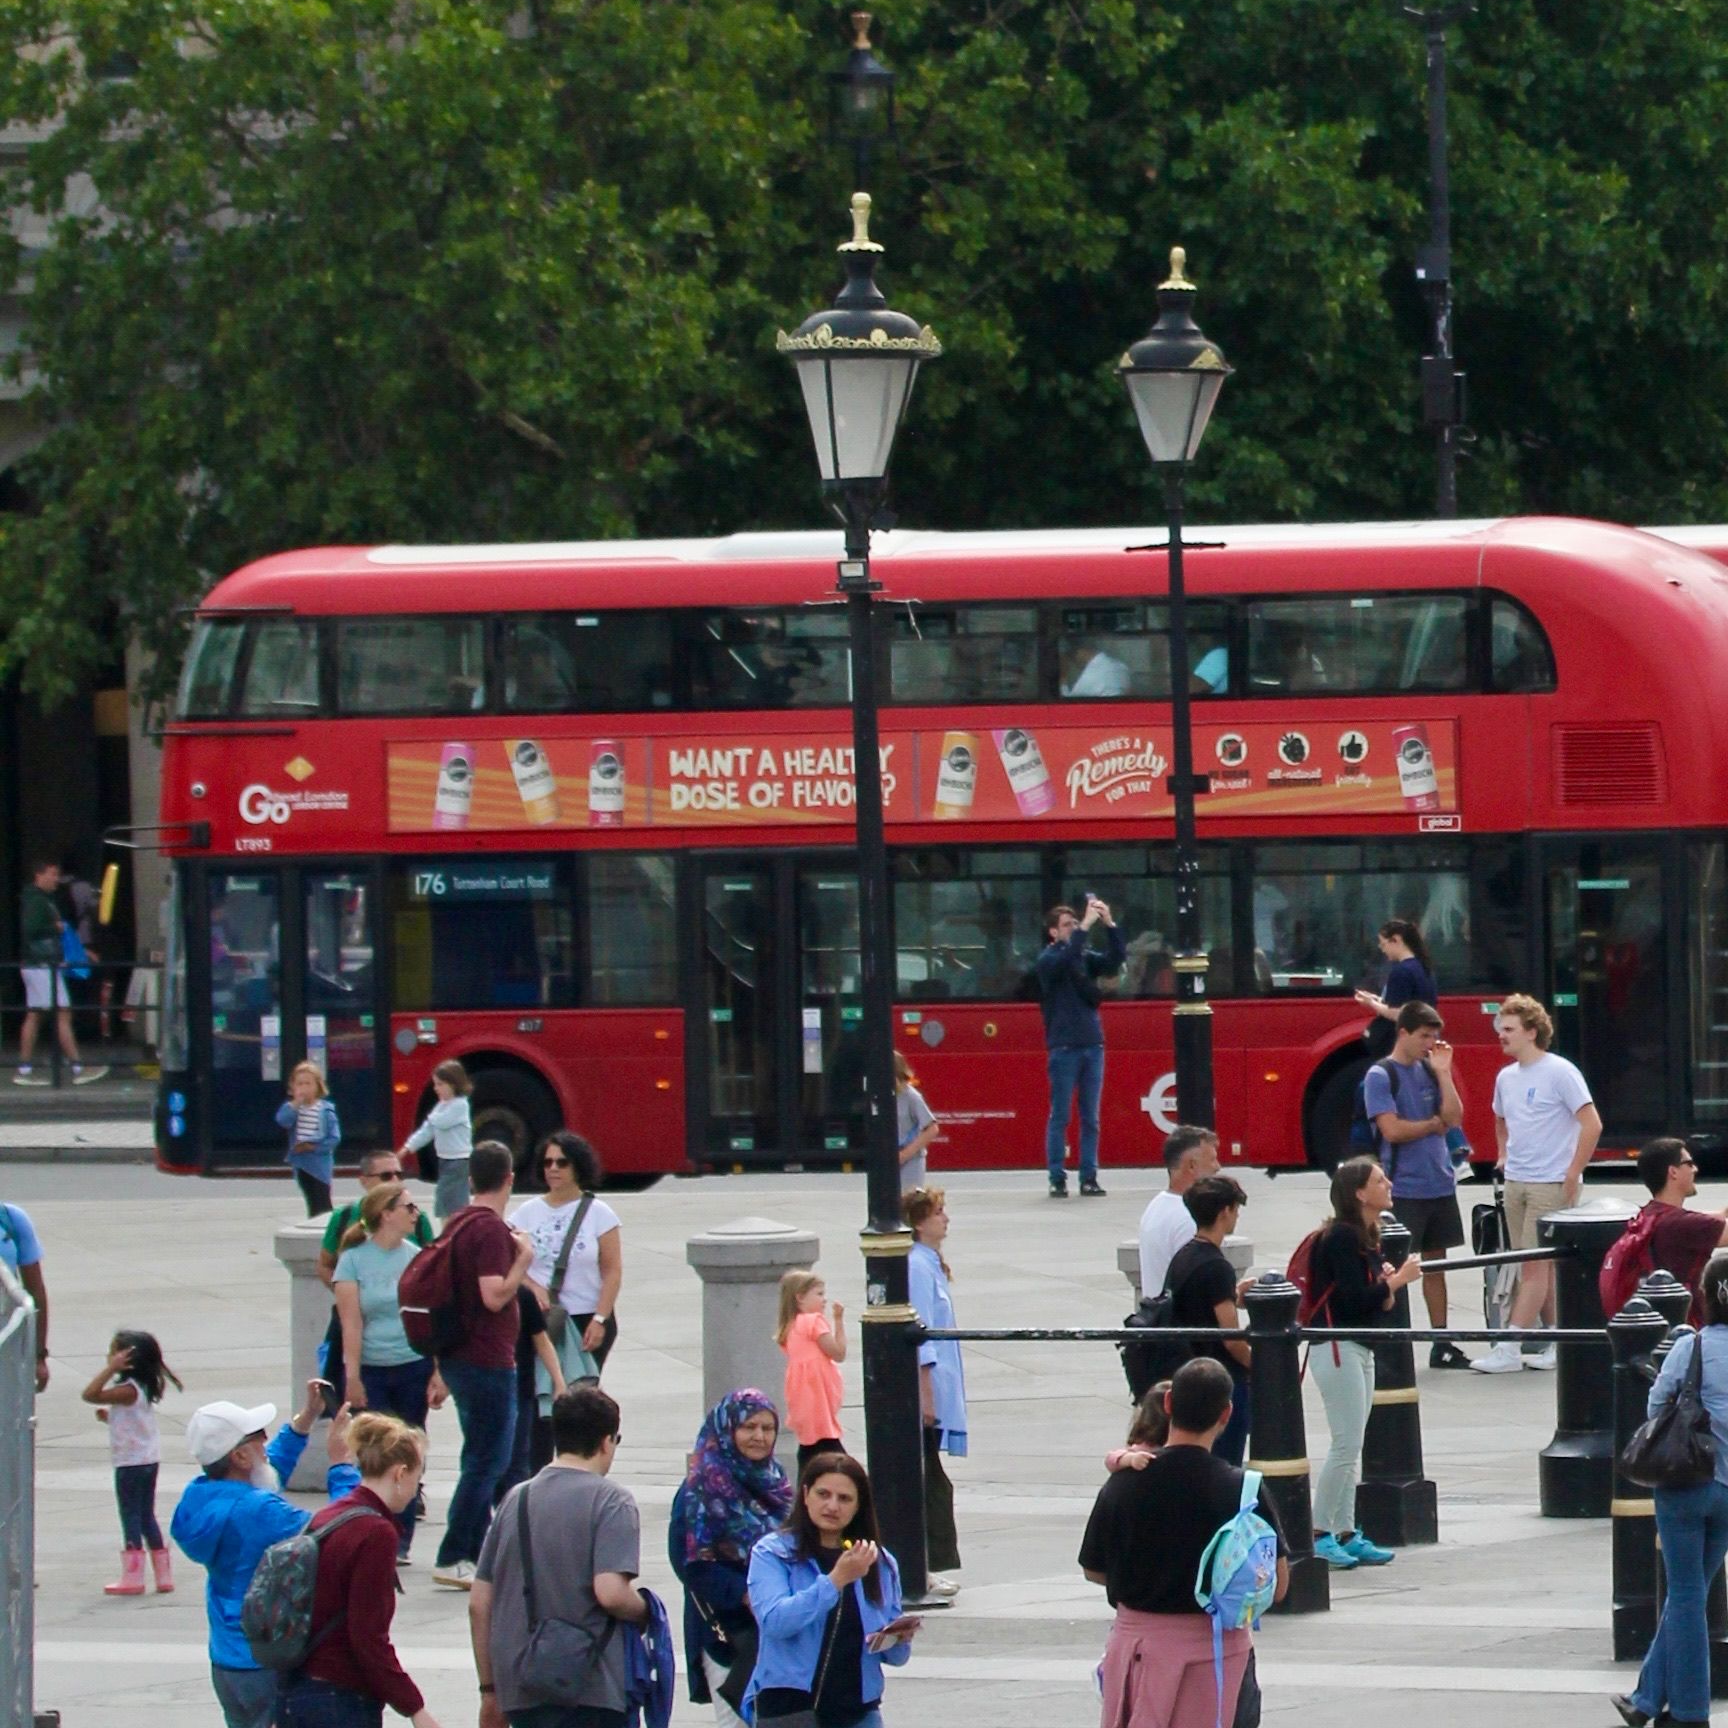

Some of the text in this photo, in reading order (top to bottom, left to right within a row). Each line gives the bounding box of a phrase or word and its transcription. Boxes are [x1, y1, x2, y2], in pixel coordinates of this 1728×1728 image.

[1133, 737, 1141, 750] A
[669, 744, 894, 778] WANT A HEALTY
[1065, 741, 1168, 809] Remedy
[239, 784, 291, 824] Go
[670, 781, 741, 810] DOSE
[748, 781, 785, 808] OF
[1105, 781, 1152, 804] FOR THAT
[1428, 818, 1453, 829] global
[414, 873, 447, 896] 176
[501, 876, 526, 889] Court
[527, 875, 550, 889] Road
